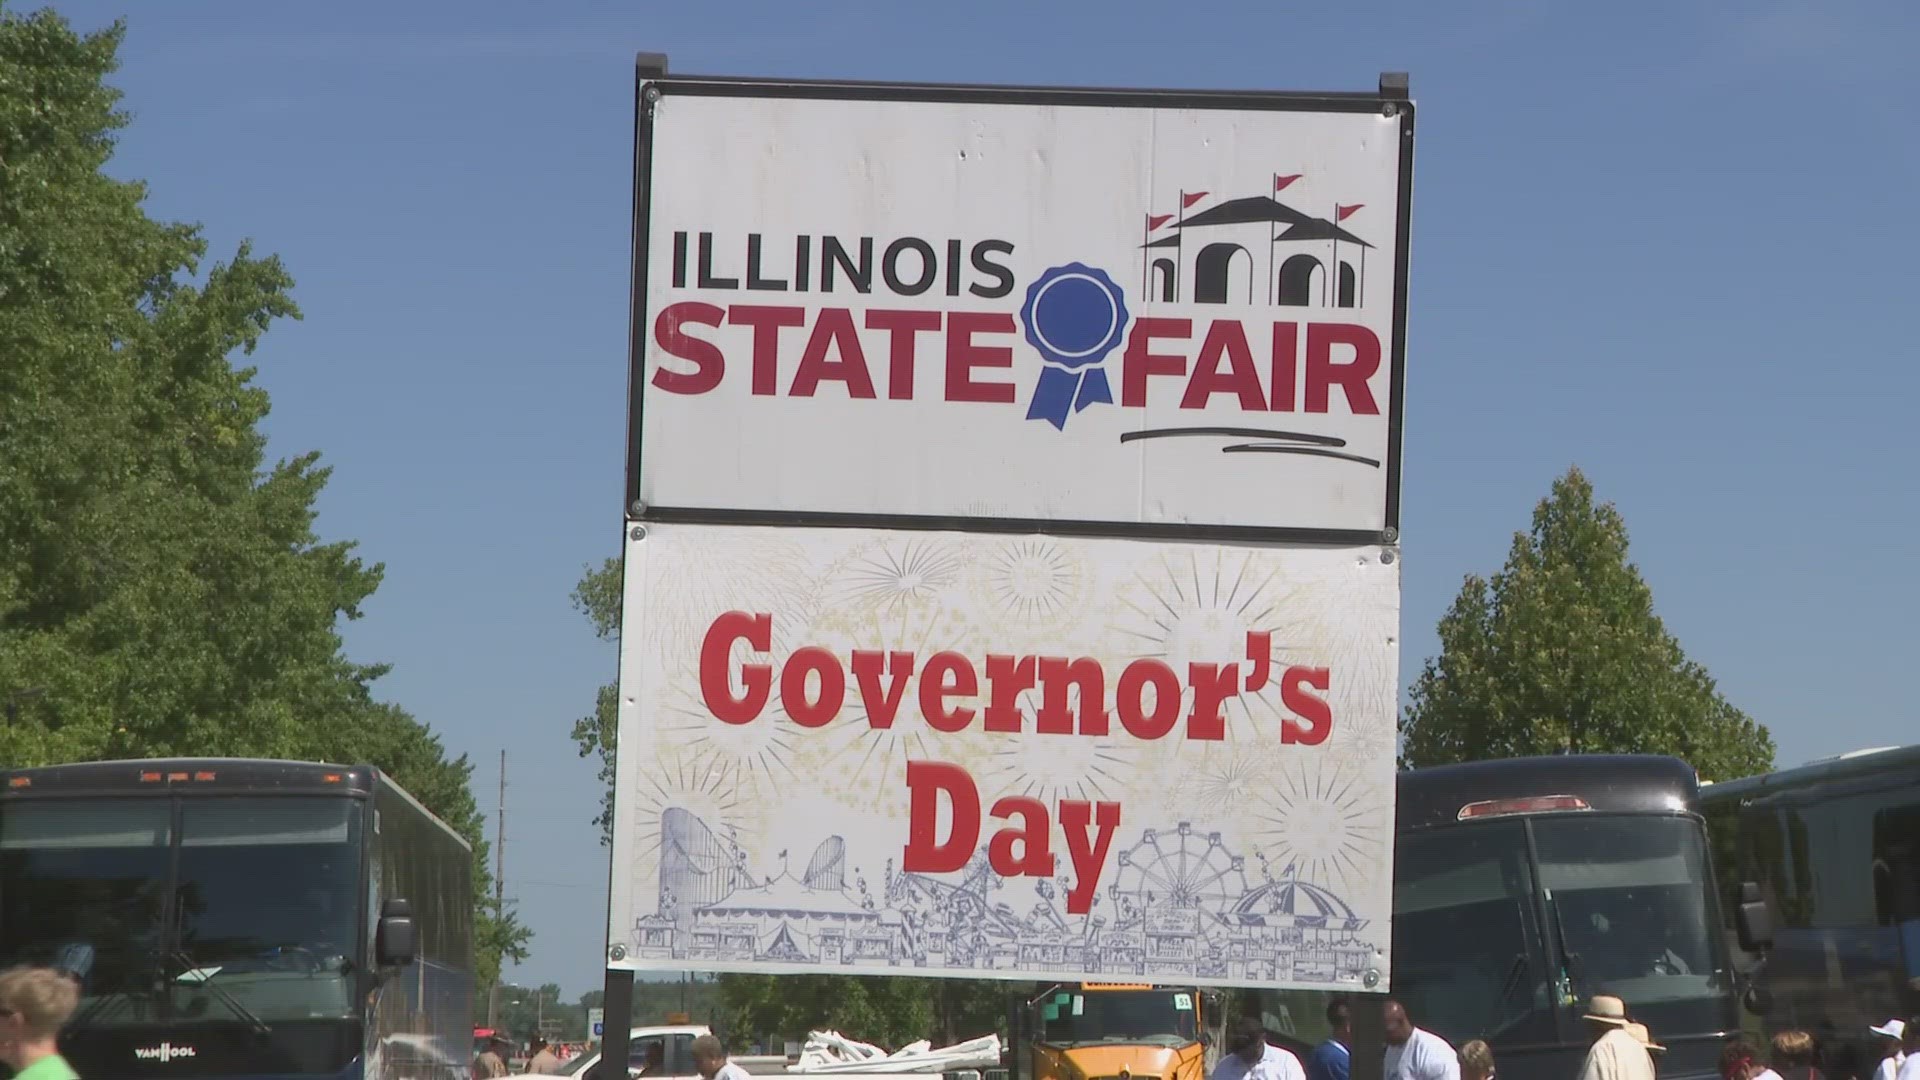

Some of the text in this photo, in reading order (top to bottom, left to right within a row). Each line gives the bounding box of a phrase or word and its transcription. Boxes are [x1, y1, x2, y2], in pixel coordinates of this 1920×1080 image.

[672, 231, 1015, 299] ILLINOIS
[652, 302, 1382, 416] STATE FAIR
[700, 611, 1333, 746] Governor's
[903, 760, 1122, 915] Day
